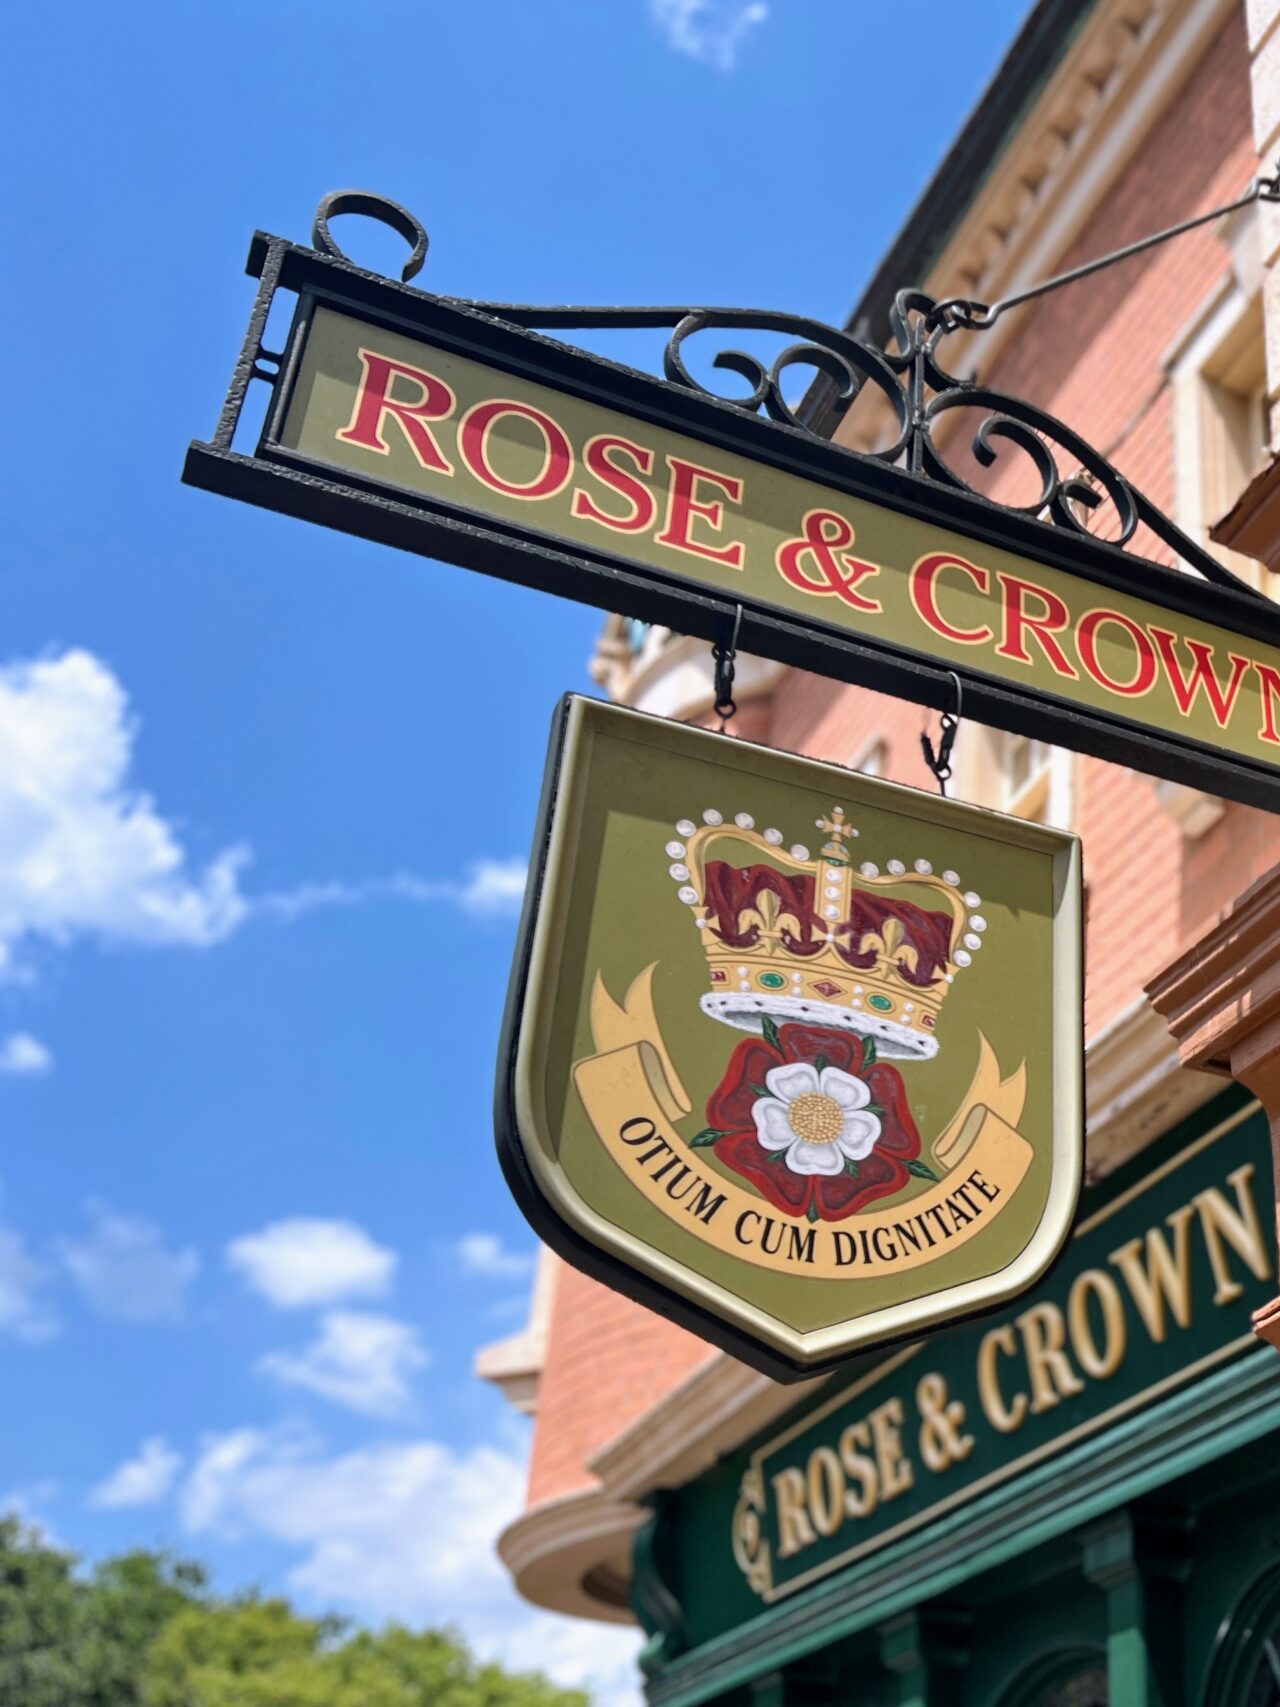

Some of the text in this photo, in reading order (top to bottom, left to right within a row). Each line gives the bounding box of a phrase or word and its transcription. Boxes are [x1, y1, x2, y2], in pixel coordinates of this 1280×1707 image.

[335, 347, 746, 571] ROSE
[775, 508, 883, 613] &
[619, 1116, 1001, 1267] OTIUM CUM DIGNITATE
[771, 1162, 1274, 1558] ROSE & CROWN
